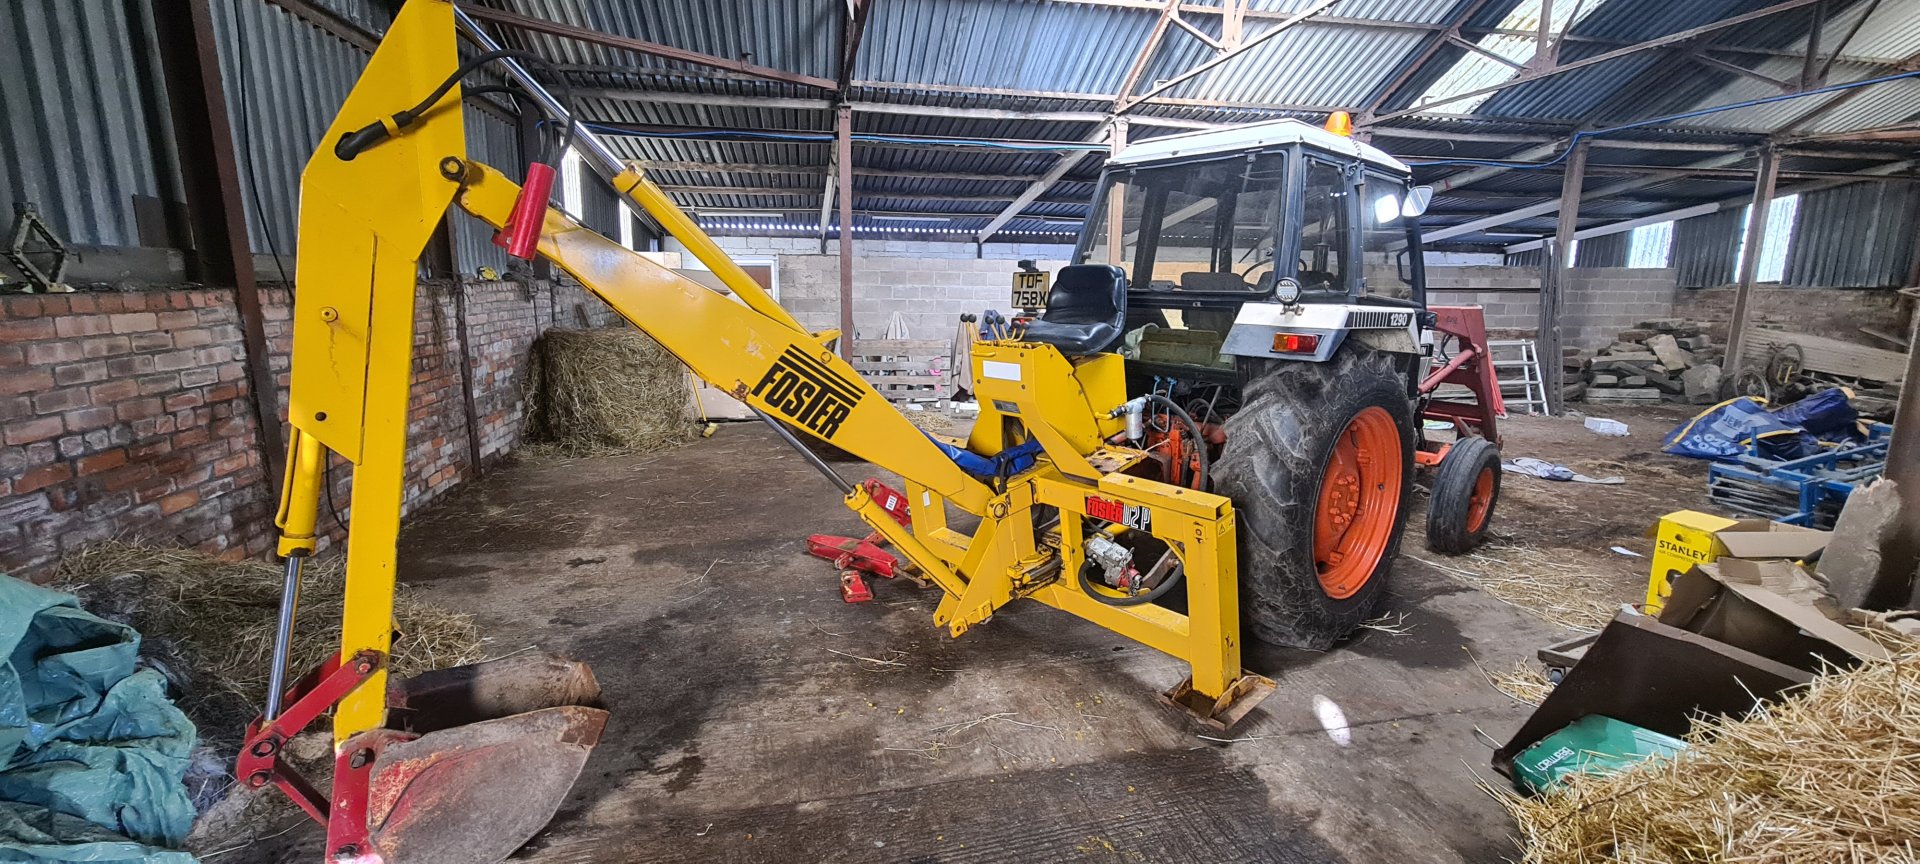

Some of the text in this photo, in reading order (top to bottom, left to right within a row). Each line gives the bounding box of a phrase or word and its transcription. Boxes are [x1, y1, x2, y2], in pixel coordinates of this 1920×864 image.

[1019, 274, 1043, 288] TDF
[1013, 291, 1047, 306] 758X
[1390, 313, 1408, 326] 1290
[751, 359, 857, 440] FOSTER
[1086, 498, 1123, 525] FOSTER
[1659, 540, 1707, 560] STANLEY
